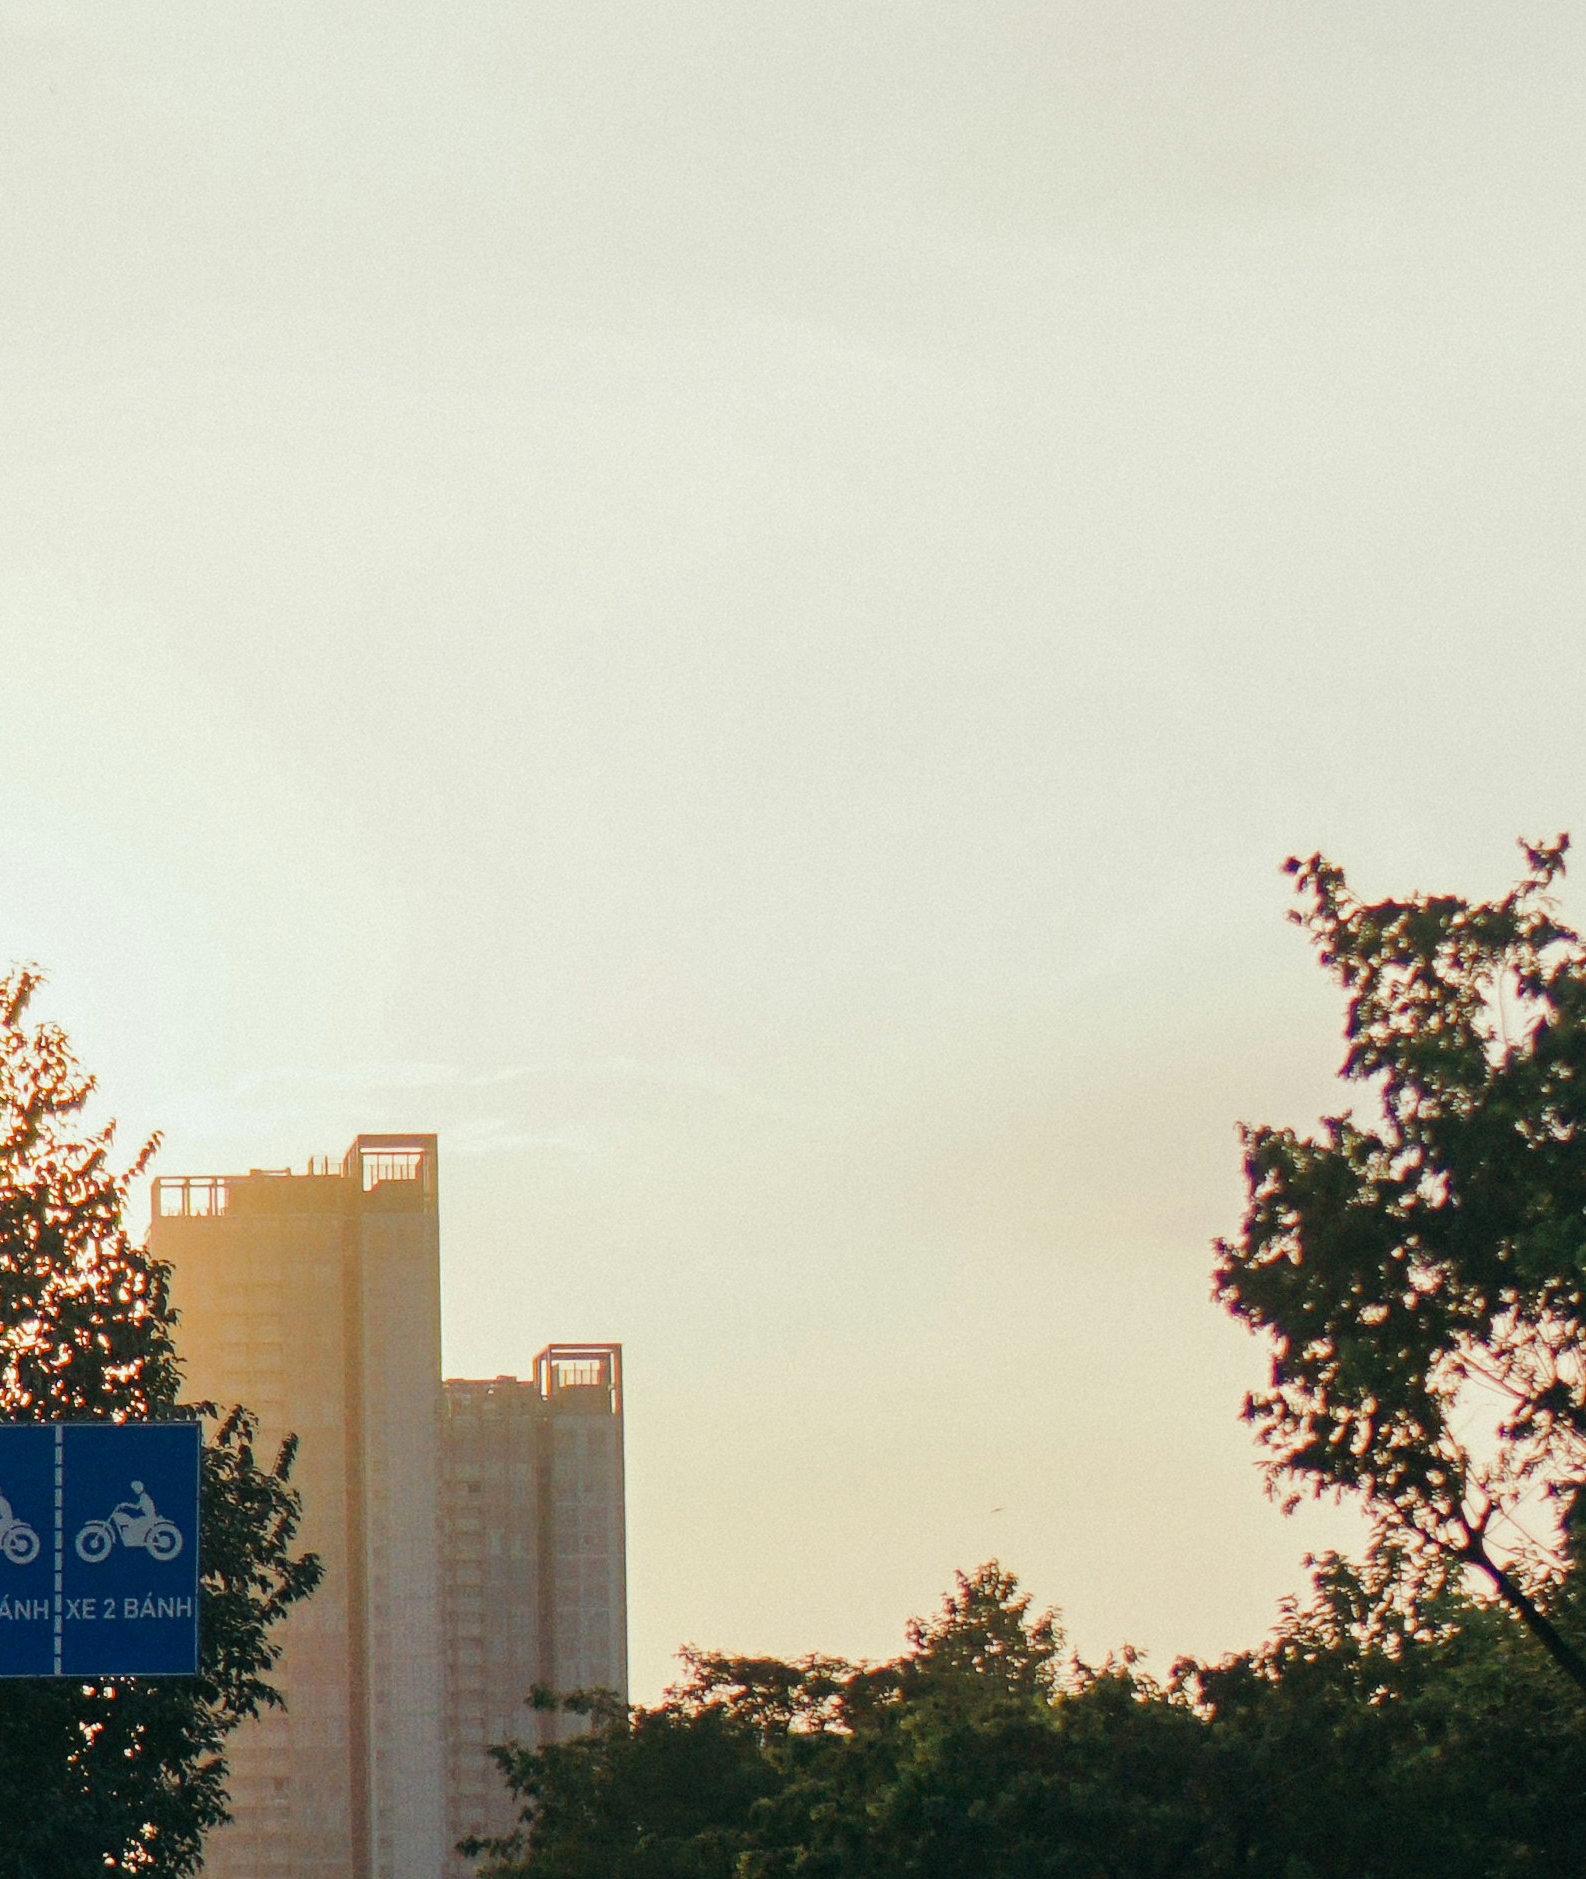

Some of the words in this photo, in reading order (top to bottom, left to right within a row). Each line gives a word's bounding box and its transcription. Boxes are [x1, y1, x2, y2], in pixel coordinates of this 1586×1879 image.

[65, 1599, 96, 1620] XE
[103, 1599, 116, 1619] 2
[123, 1591, 192, 1619] BÁNH
